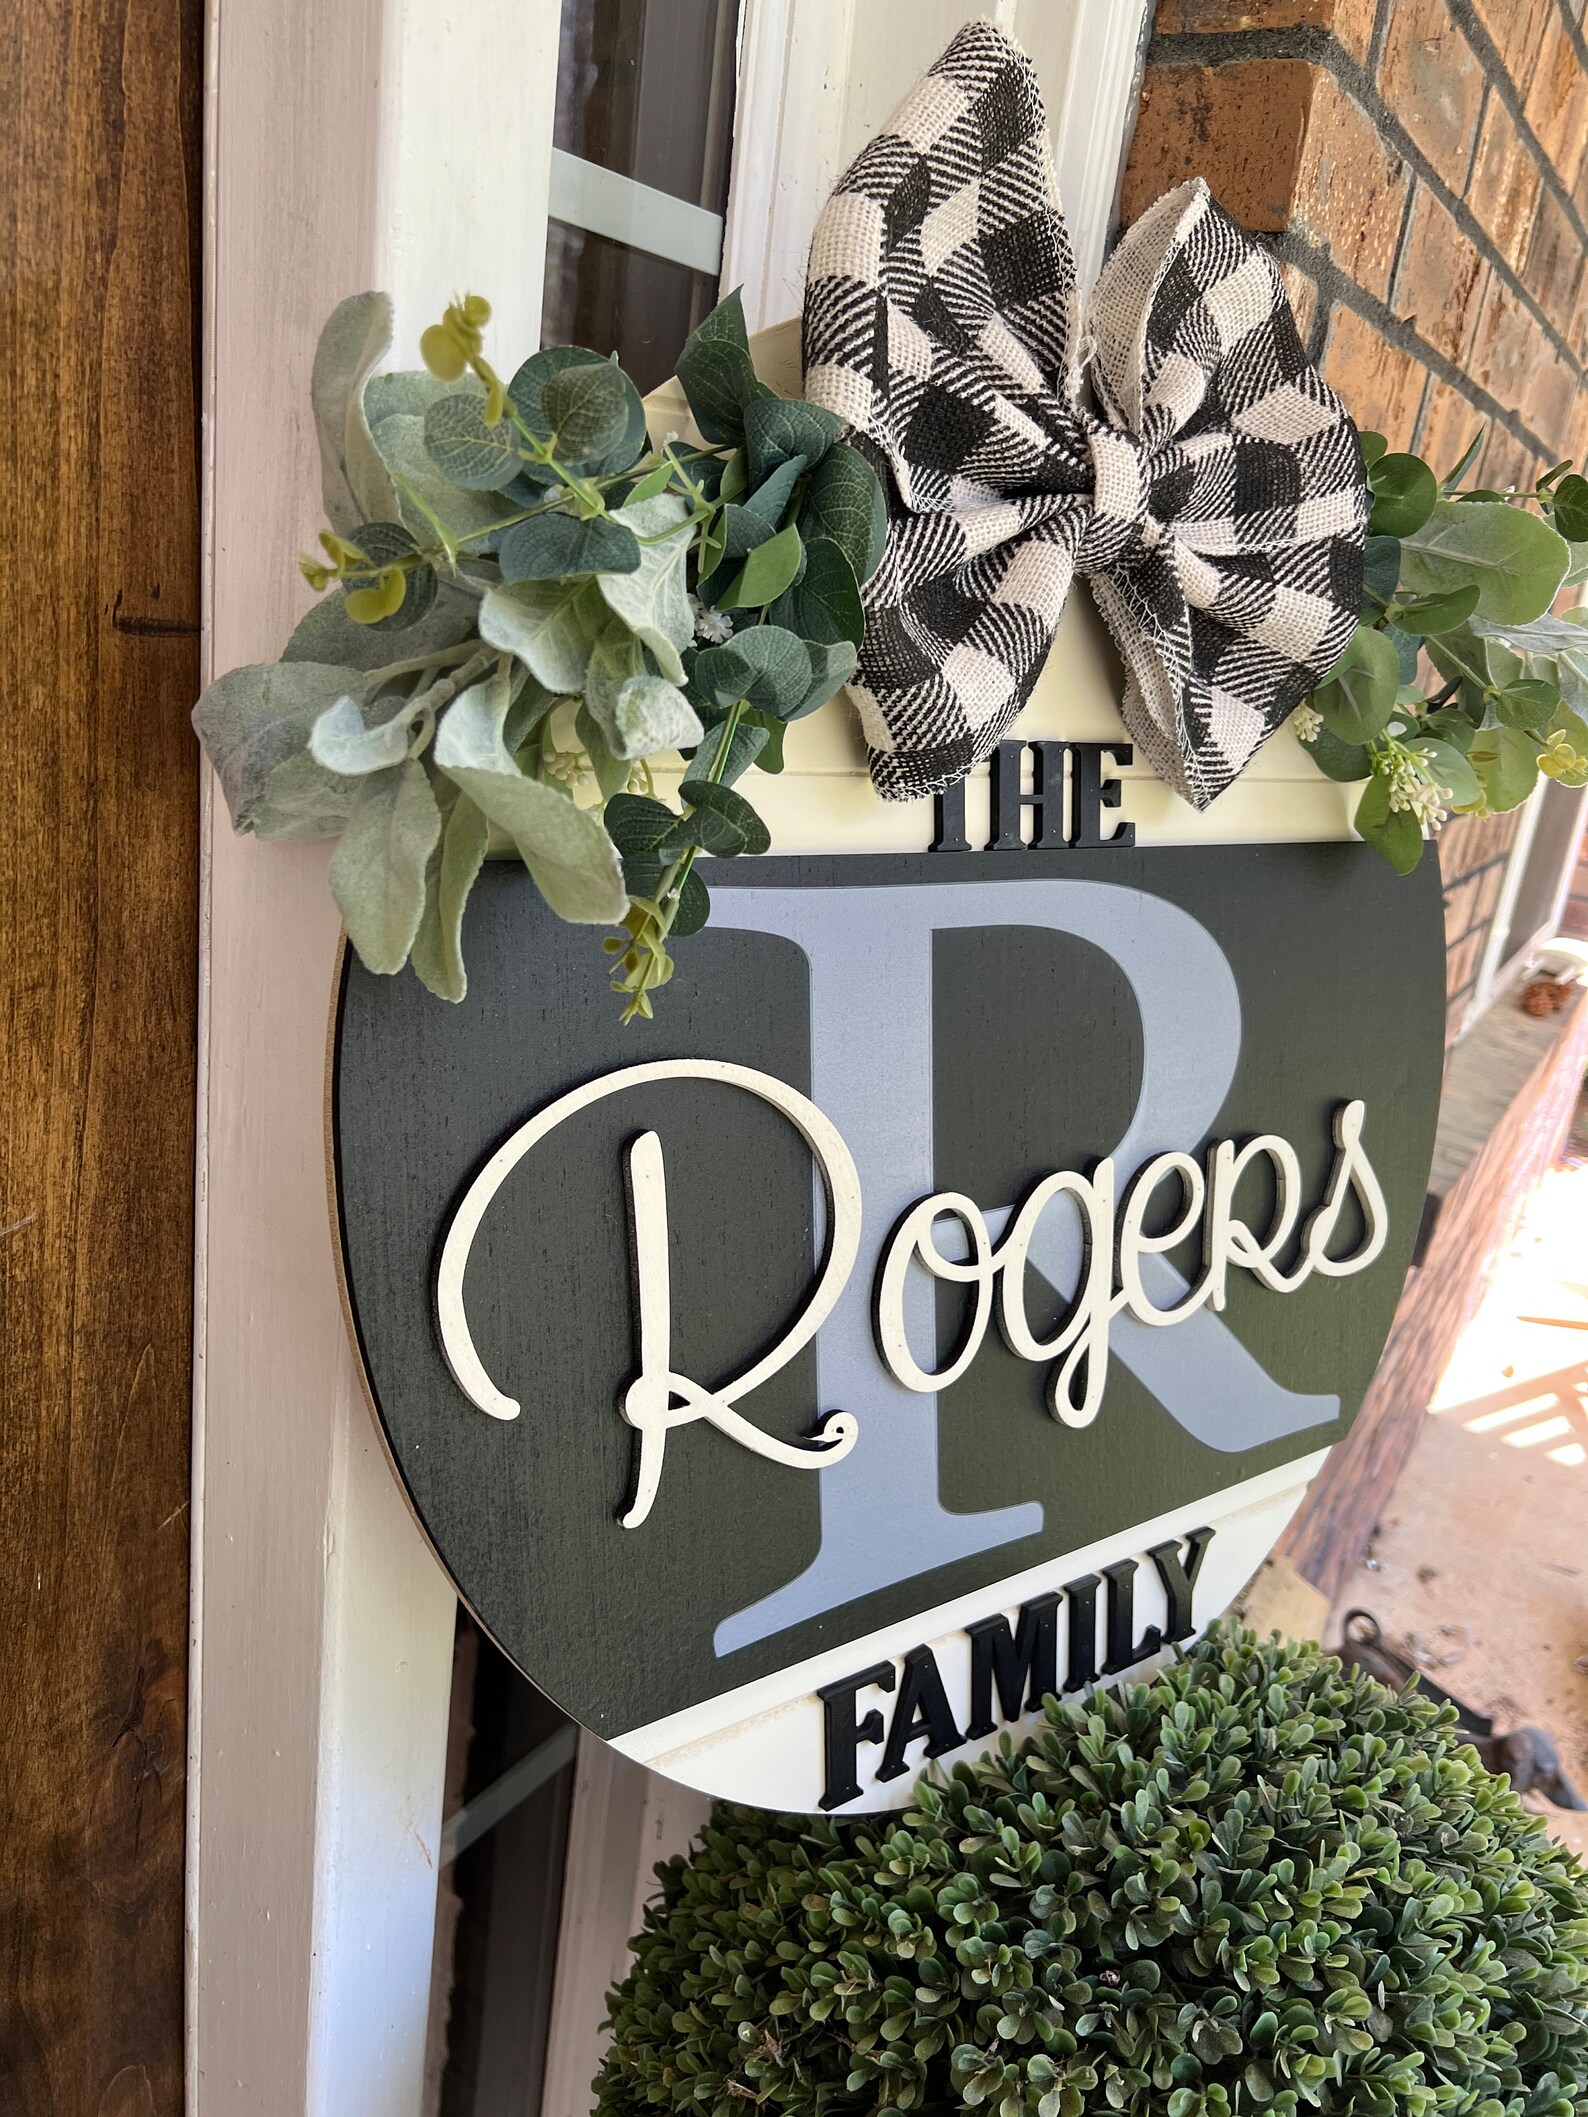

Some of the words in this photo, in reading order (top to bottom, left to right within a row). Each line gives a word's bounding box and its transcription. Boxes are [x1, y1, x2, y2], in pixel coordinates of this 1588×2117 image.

[434, 1057, 1389, 1530] Rogers
[700, 878, 1341, 1657] R
[817, 1526, 1217, 1812] FAMILY
